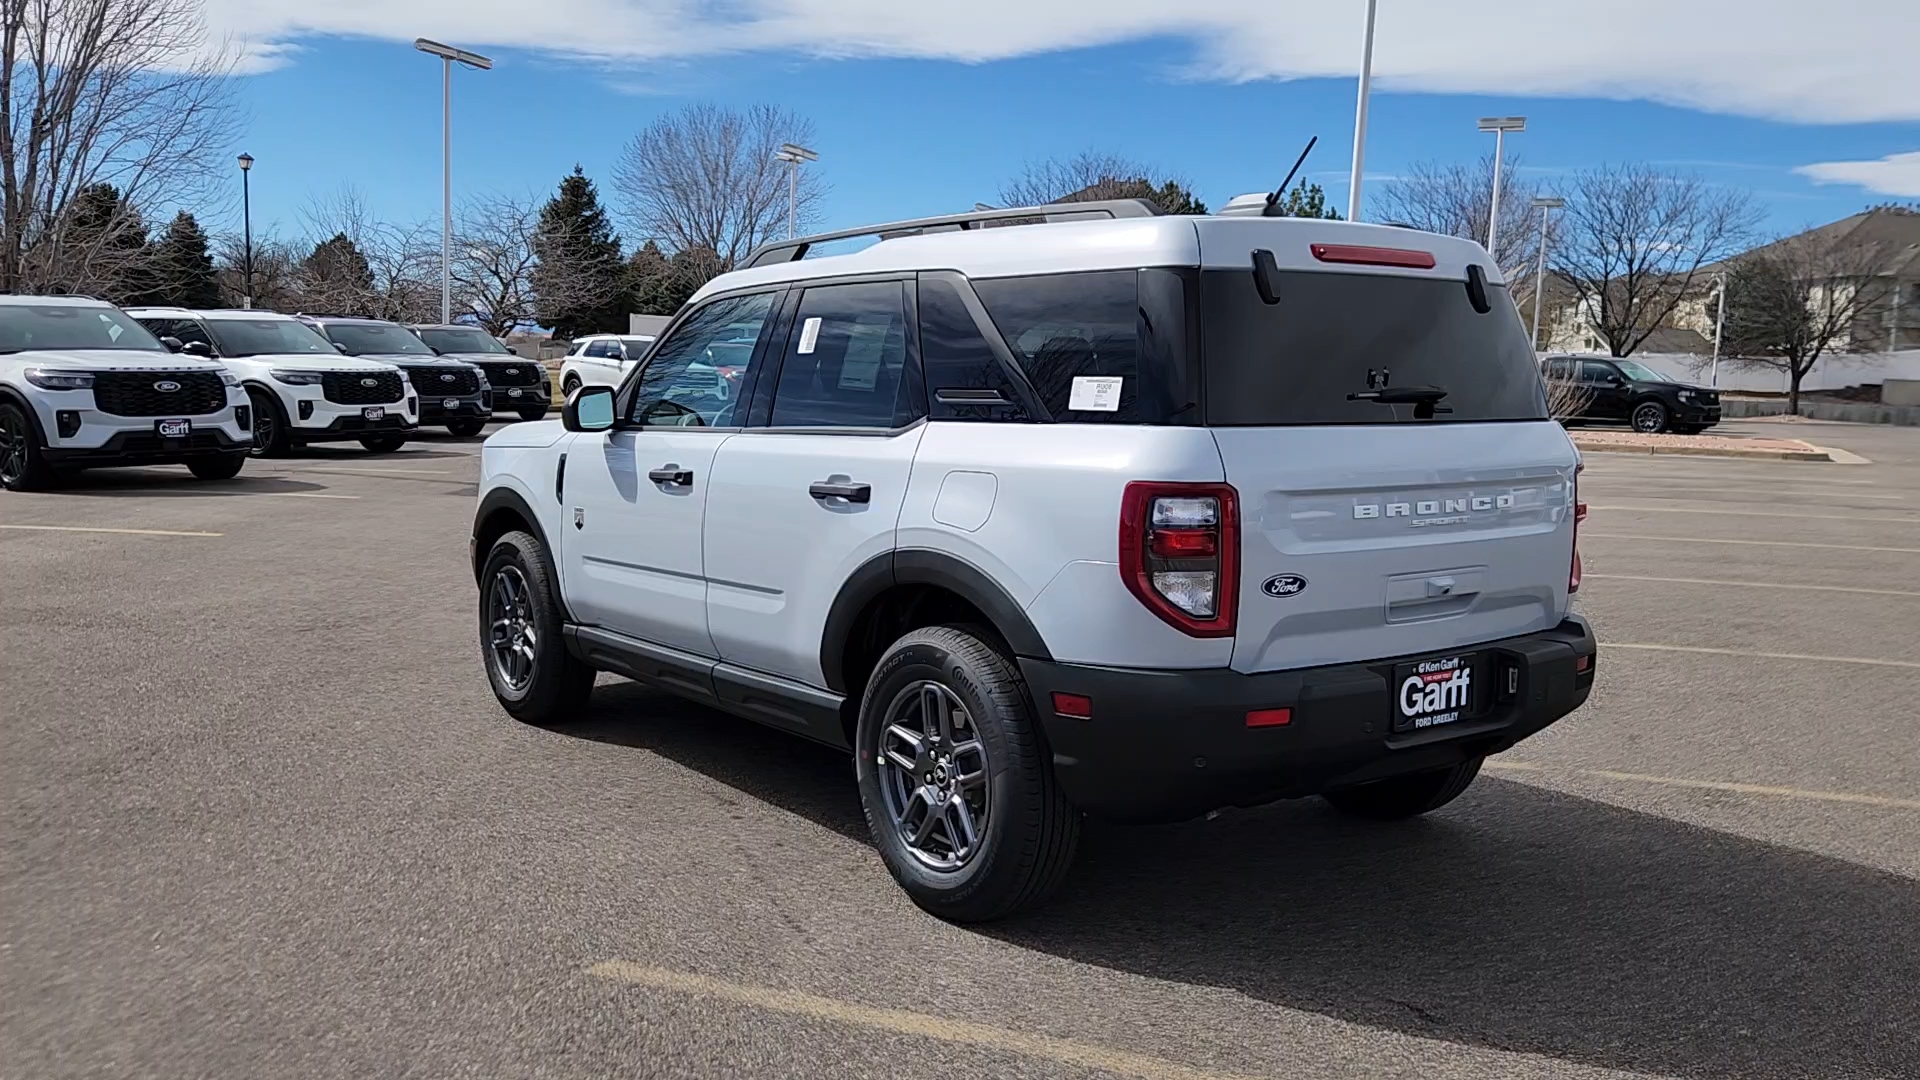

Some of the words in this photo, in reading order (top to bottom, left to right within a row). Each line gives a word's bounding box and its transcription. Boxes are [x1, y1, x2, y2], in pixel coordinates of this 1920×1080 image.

[159, 422, 190, 435] Garff
[1353, 494, 1515, 519] BRONCO
[1410, 515, 1471, 527] SPORT
[1425, 661, 1440, 672] Ken
[1440, 657, 1459, 670] Garff
[1400, 667, 1470, 716] Garff
[1415, 717, 1432, 728] FORD
